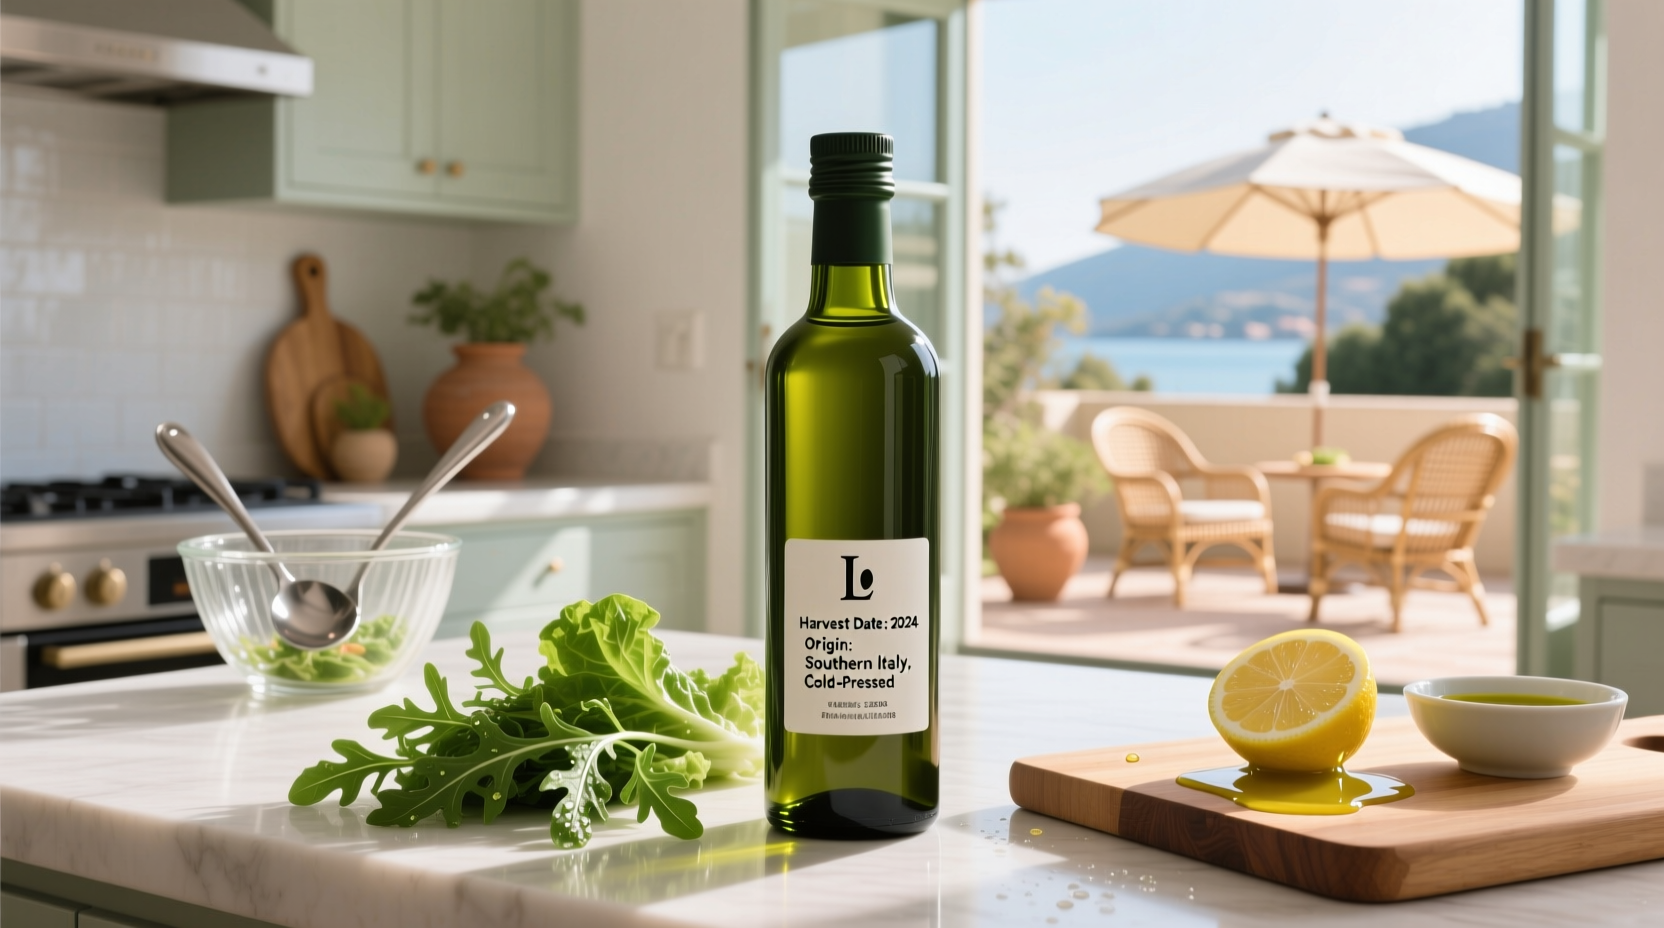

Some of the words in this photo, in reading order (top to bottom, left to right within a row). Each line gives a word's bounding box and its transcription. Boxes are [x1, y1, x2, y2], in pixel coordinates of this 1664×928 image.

[799, 616, 850, 630] Harvest
[853, 616, 888, 630] Date:
[890, 615, 919, 629] 2024
[804, 637, 853, 655] Origin:
[805, 656, 873, 671] Southern
[877, 654, 912, 674] Italy,
[804, 674, 895, 689] Cold-Pressed
